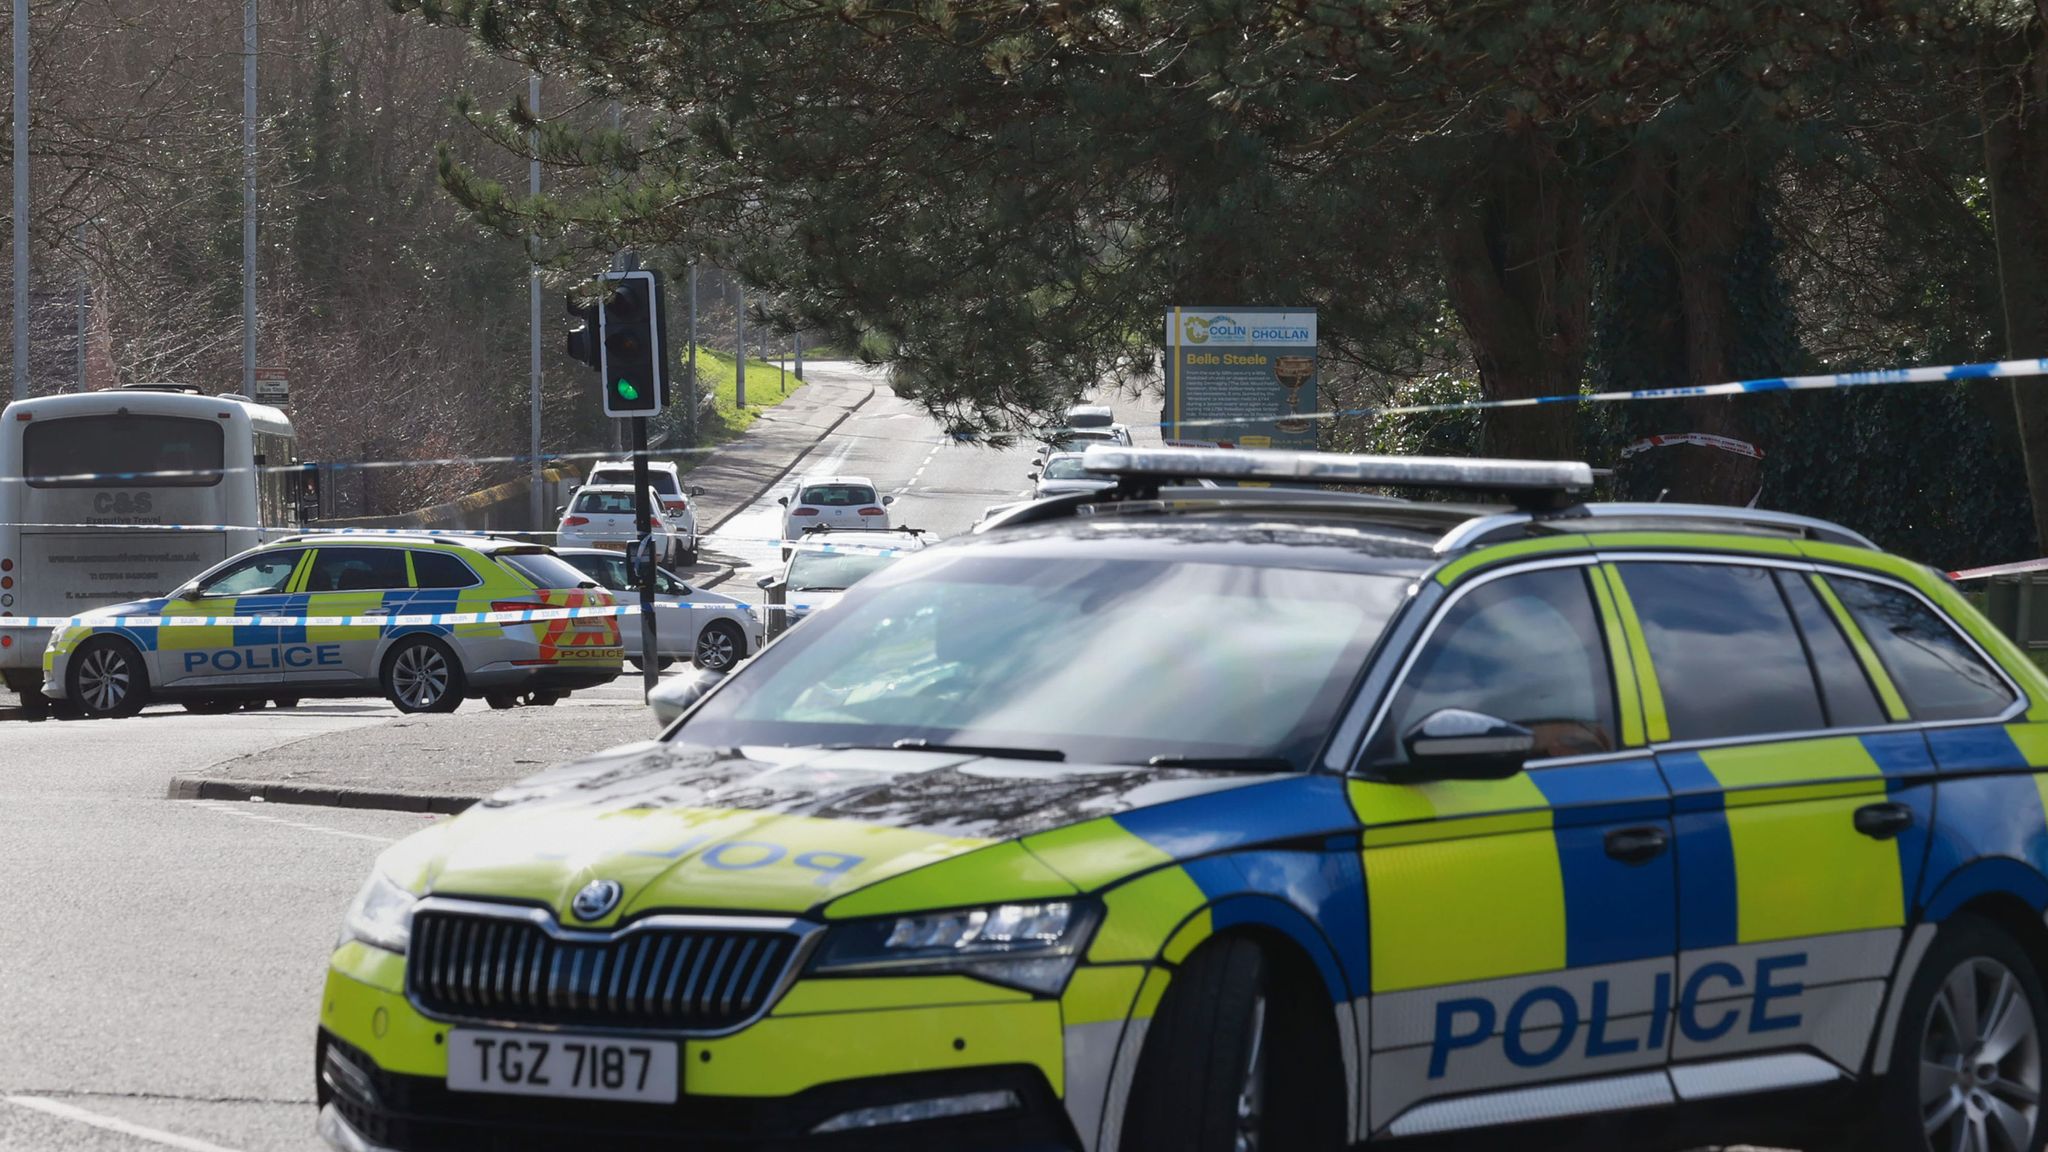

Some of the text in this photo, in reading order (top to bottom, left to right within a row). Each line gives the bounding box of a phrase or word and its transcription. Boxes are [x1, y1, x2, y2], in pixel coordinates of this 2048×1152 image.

[1209, 326, 1246, 335] COLIN
[1252, 330, 1308, 339] CHOLLAN
[1187, 354, 1267, 364] Belle Steele
[94, 492, 152, 513] C&S
[184, 644, 343, 672] POLICE
[561, 649, 623, 657] POLICE
[1427, 952, 1808, 1080] POLICE
[473, 1038, 652, 1091] TGZ 7187
